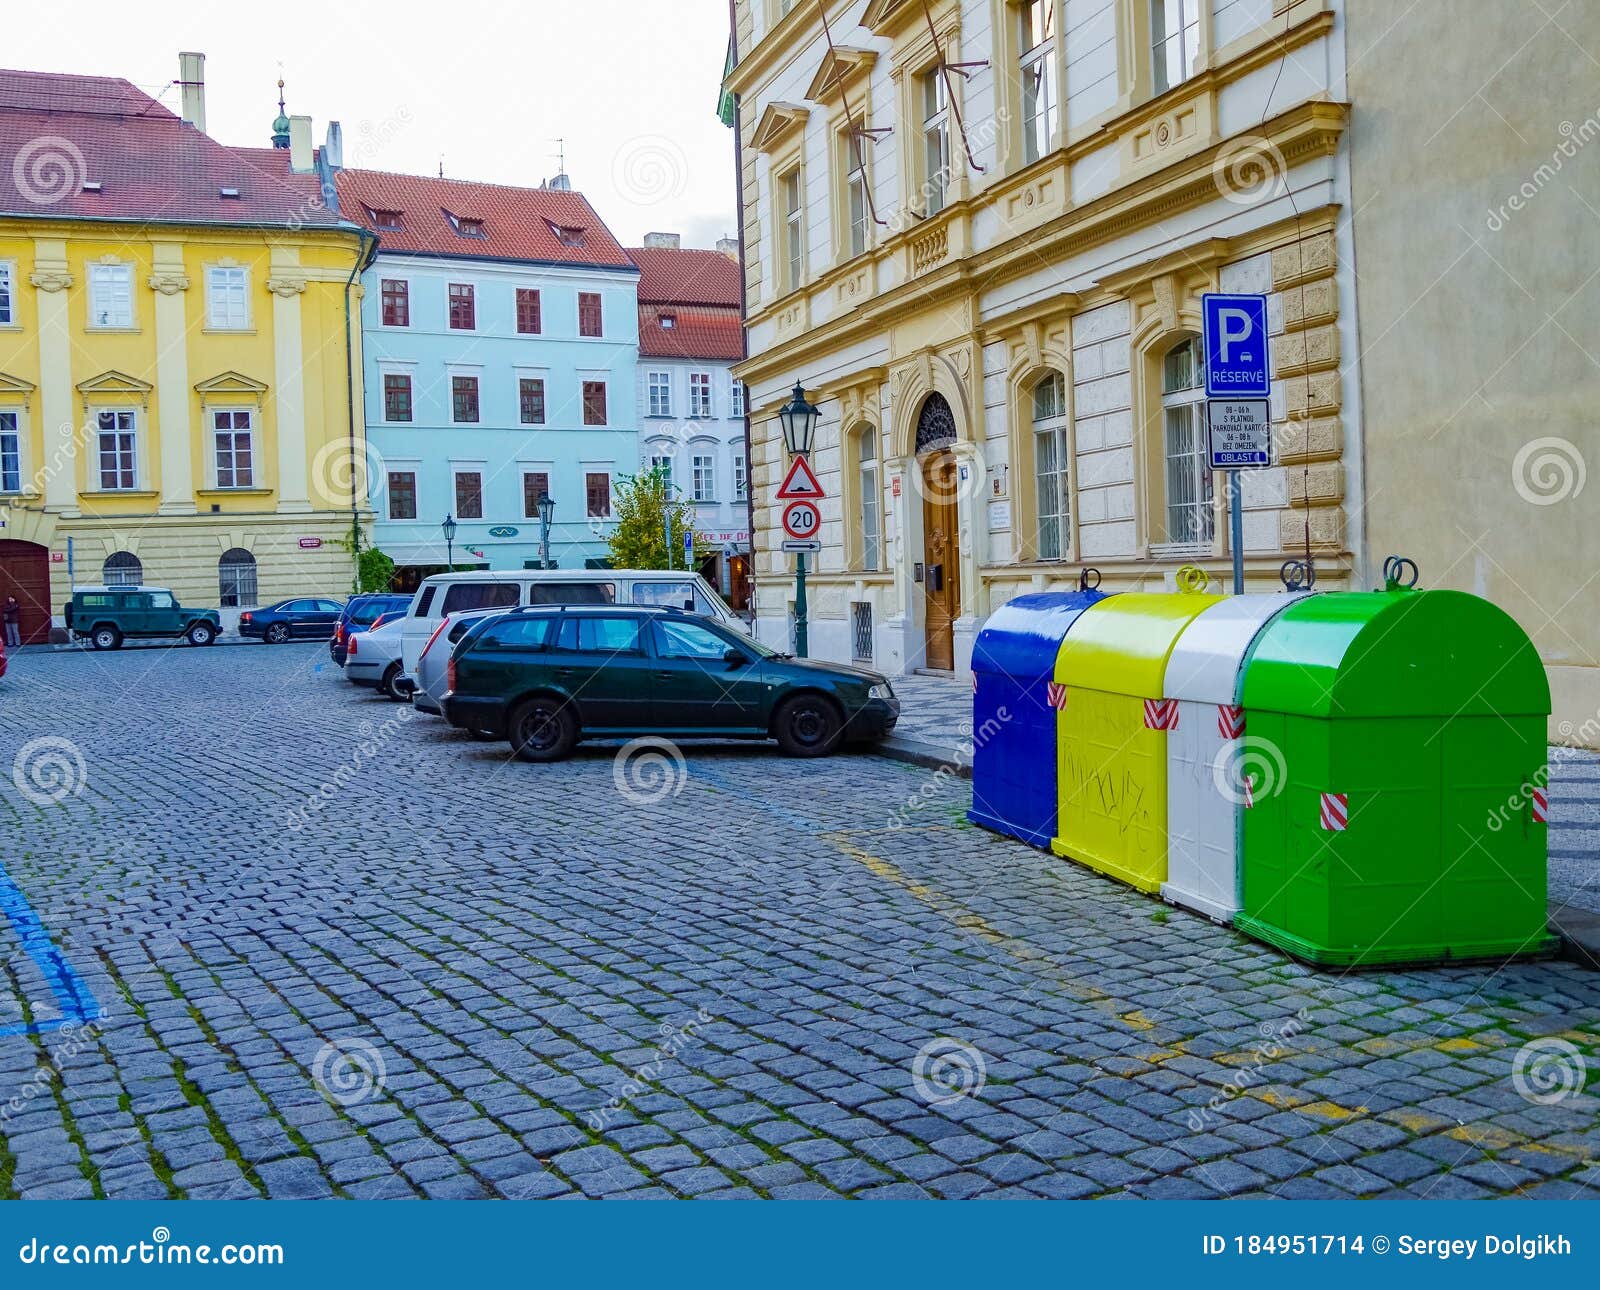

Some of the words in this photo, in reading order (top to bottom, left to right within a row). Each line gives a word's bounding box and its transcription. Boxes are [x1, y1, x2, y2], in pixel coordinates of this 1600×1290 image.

[1218, 308, 1252, 363] P
[1212, 369, 1264, 383] RÉSERVÉ
[1221, 453, 1253, 462] OBLAST
[791, 511, 813, 528] 20
